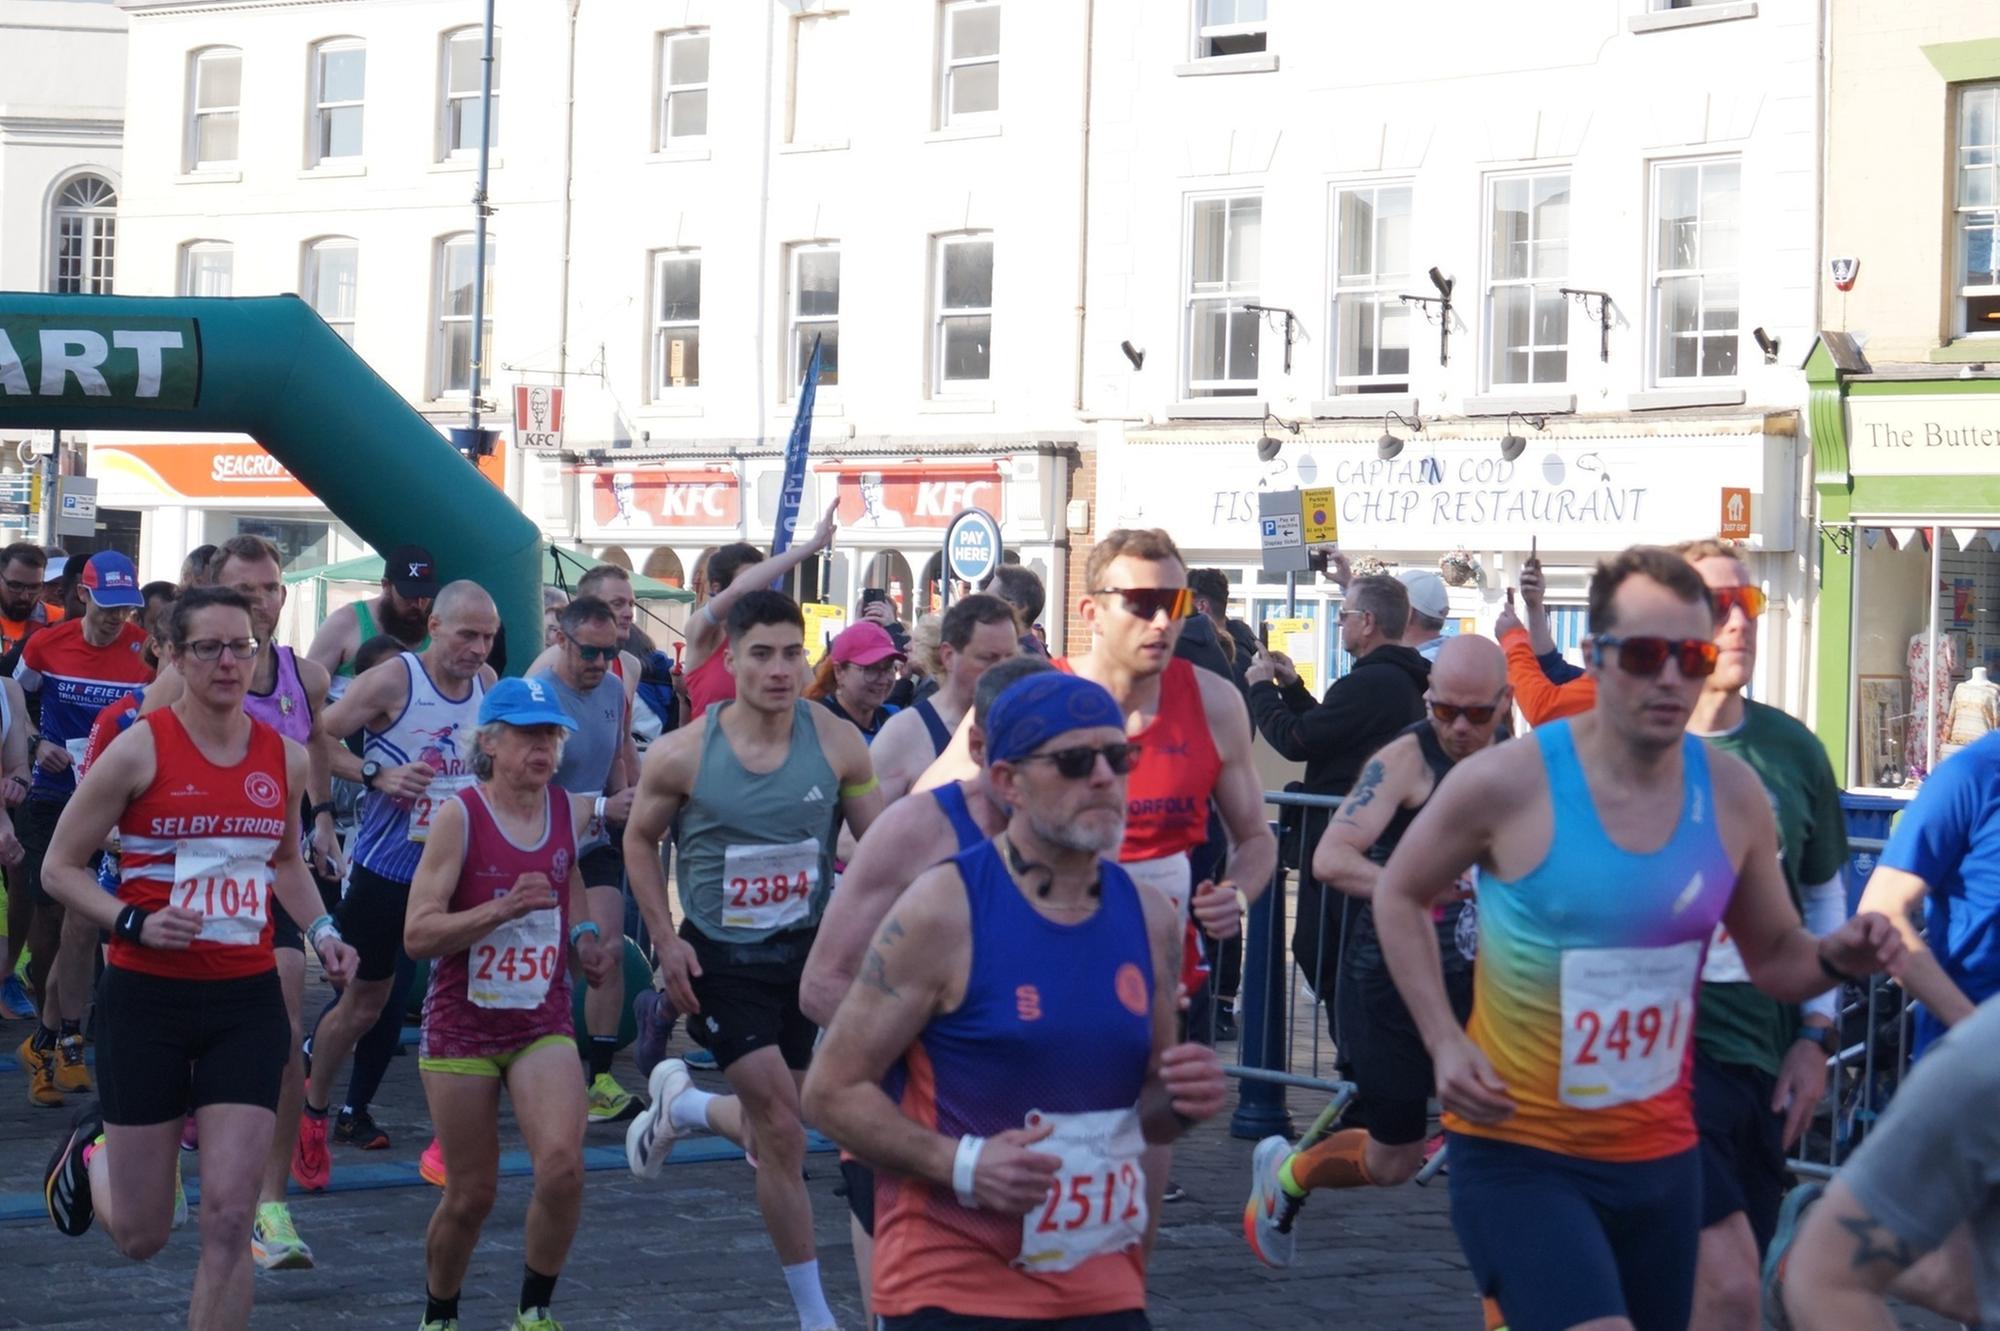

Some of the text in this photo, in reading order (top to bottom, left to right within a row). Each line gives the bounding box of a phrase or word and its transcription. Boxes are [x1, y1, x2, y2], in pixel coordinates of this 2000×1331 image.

[525, 433, 554, 446] KFC
[1865, 422, 1914, 448] The
[1336, 458, 1515, 486] CAPTAIN COD
[661, 482, 725, 517] KFC
[914, 480, 989, 516] KFC
[1212, 487, 1648, 525] FIS CHIP RESTAURANT
[955, 546, 989, 561] HERE
[960, 531, 984, 545] PAY
[151, 815, 219, 836] SELBY
[180, 876, 259, 918] 2104
[730, 871, 809, 908] 2384
[475, 944, 558, 983] 2450
[1574, 1000, 1681, 1066] 2491
[1036, 1162, 1139, 1233] 2512
